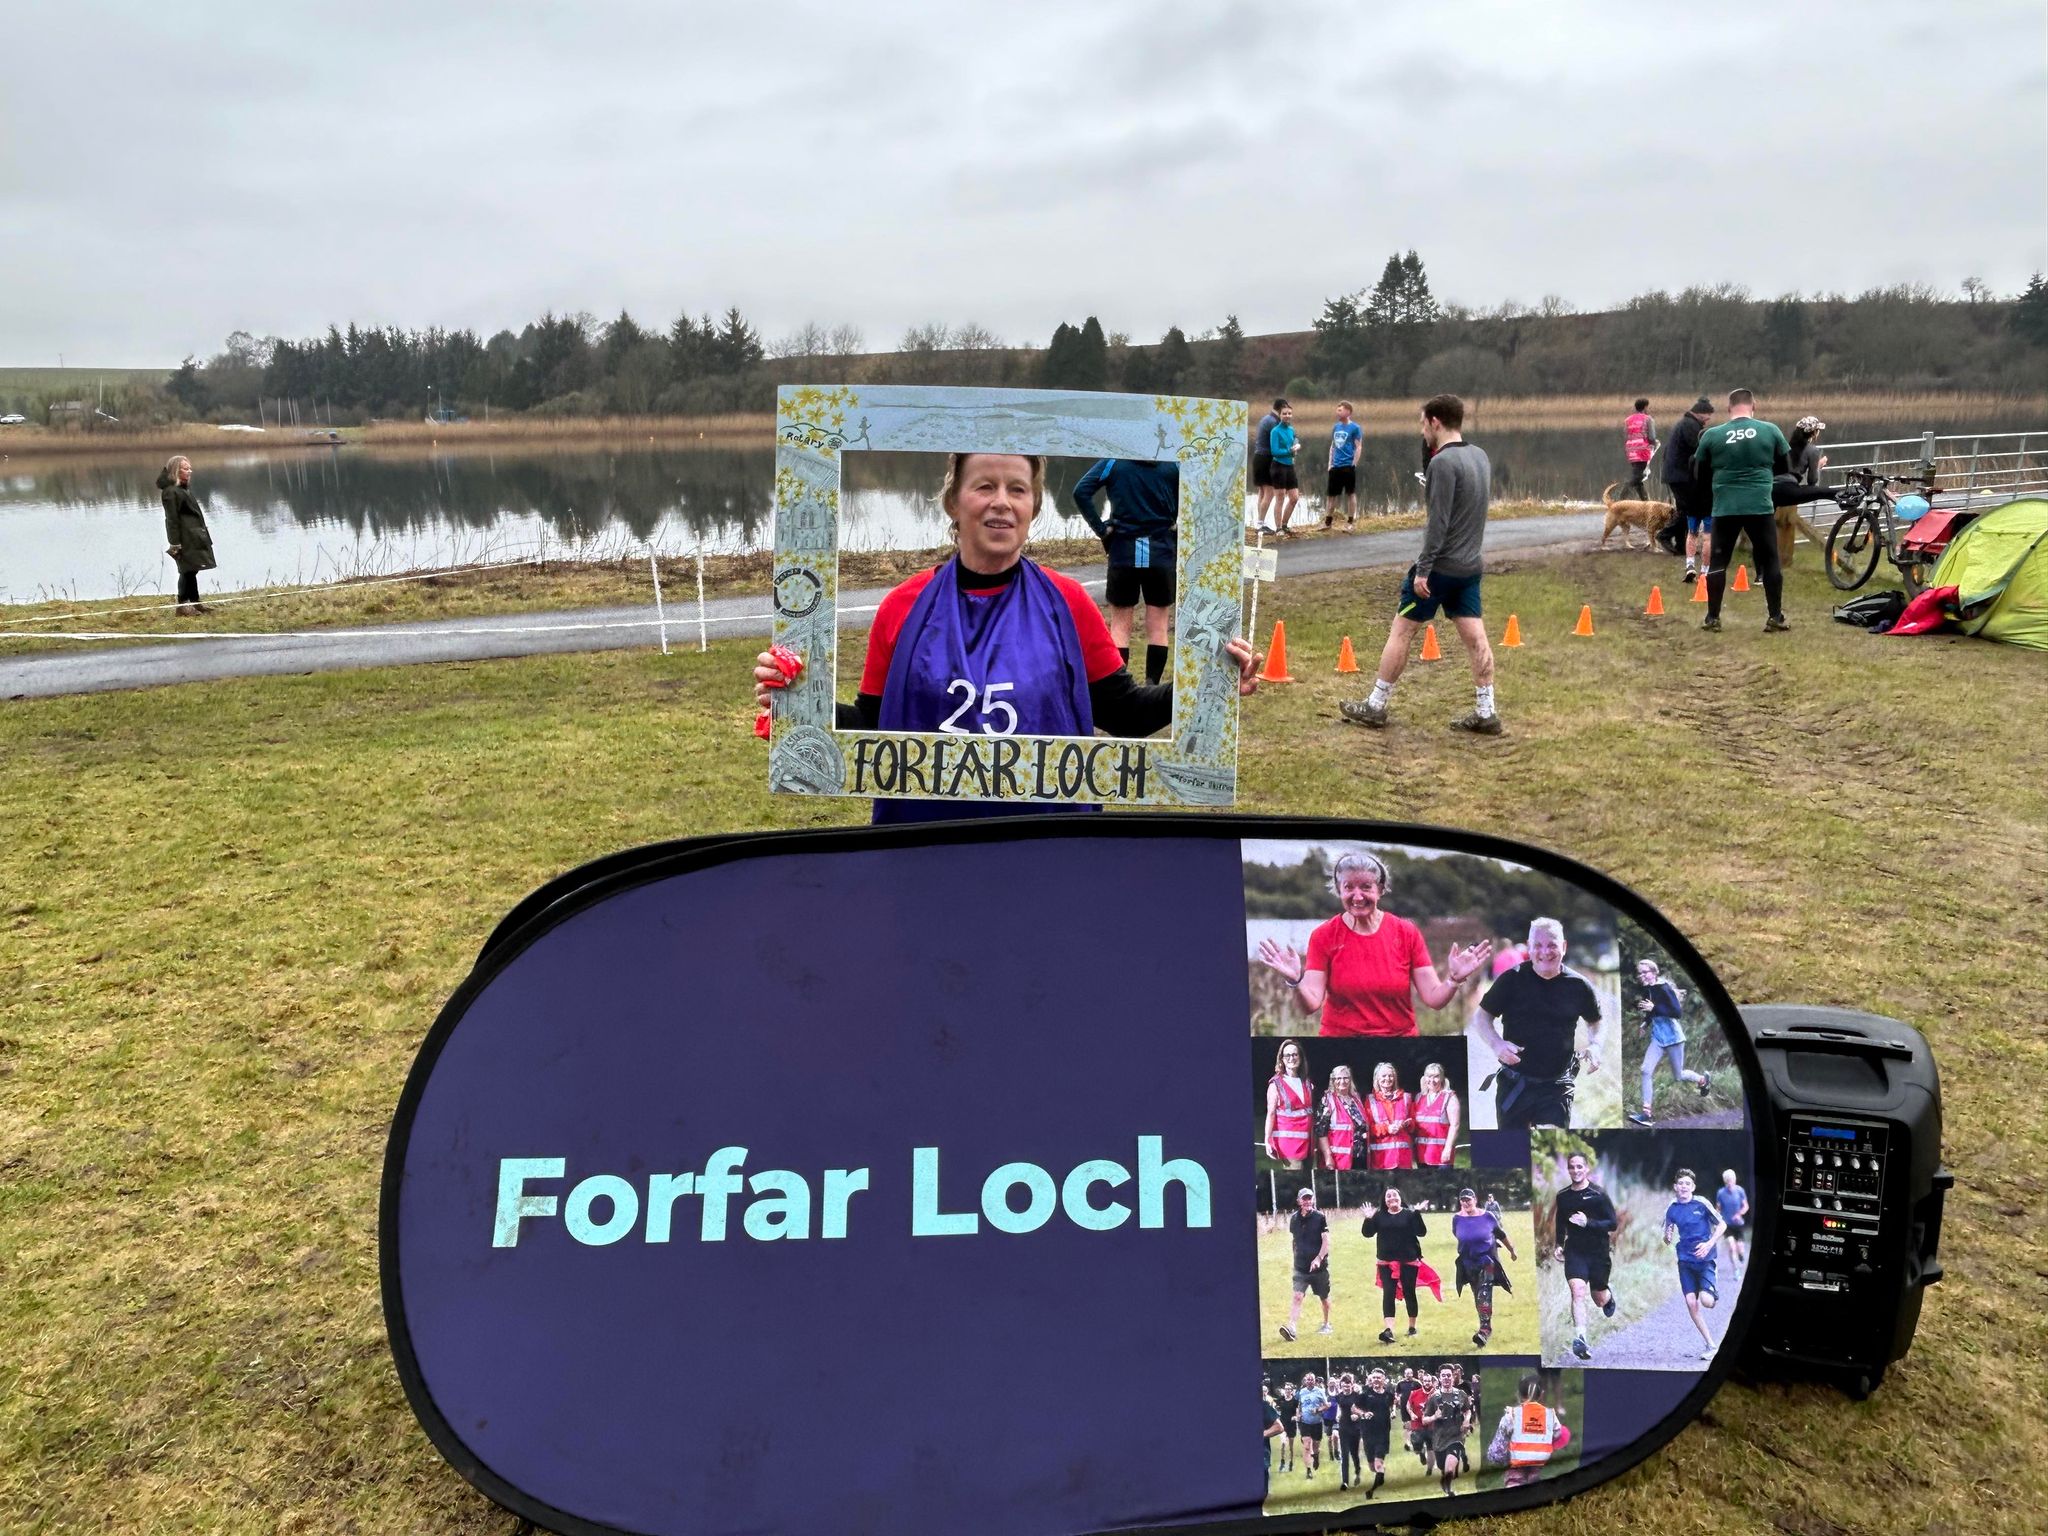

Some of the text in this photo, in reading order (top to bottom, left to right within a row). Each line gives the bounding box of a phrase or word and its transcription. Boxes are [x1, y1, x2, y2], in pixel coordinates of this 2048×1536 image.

[1726, 428, 1757, 444] 250
[938, 678, 1018, 735] 25
[850, 737, 1152, 799] FORFAR LOCH
[492, 1135, 1212, 1248] Forfar Loch
